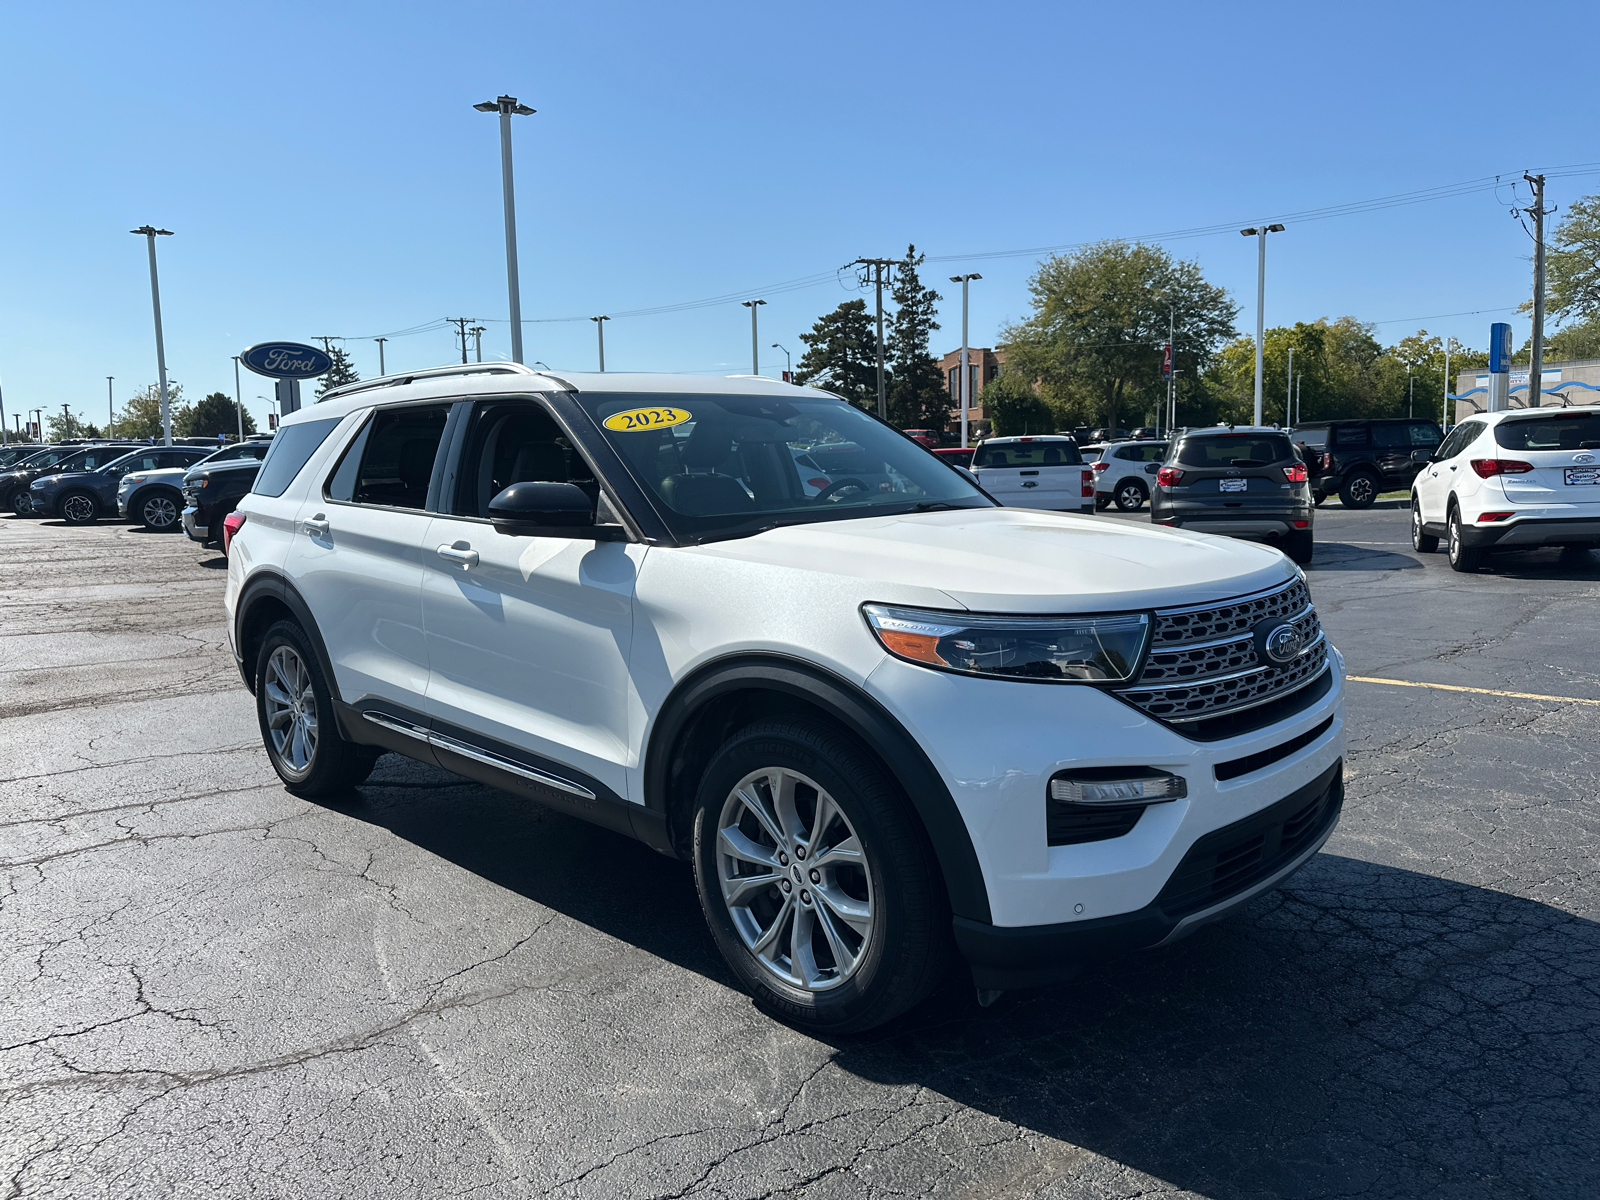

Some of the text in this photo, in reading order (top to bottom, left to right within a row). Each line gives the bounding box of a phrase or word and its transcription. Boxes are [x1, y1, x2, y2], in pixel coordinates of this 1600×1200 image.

[264, 349, 316, 371] Ford
[621, 409, 677, 429] 2023
[754, 743, 814, 767] MICHELIN
[758, 986, 817, 1019] MICHELIN
